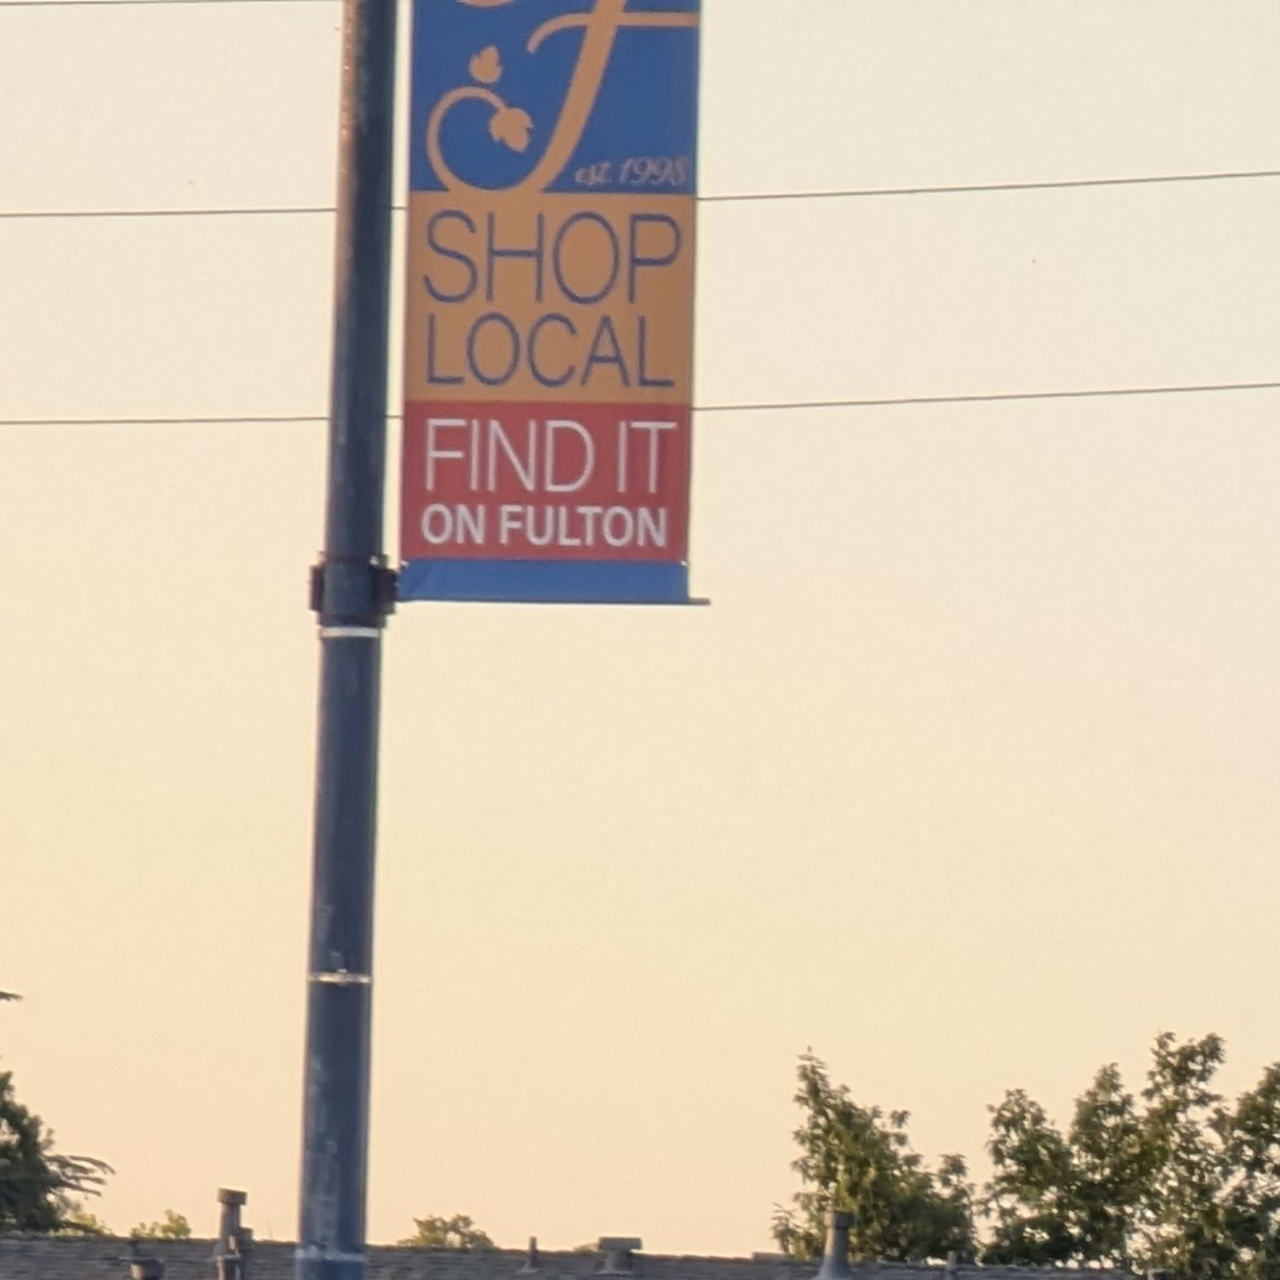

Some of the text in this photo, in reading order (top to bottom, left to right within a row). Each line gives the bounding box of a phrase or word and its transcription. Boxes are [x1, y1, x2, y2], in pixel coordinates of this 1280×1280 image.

[619, 155, 689, 186] 1998
[422, 209, 682, 304] SHOP
[424, 312, 676, 388] LOCAL
[424, 418, 678, 495] FIND IT
[421, 503, 668, 547] ON FULTON
